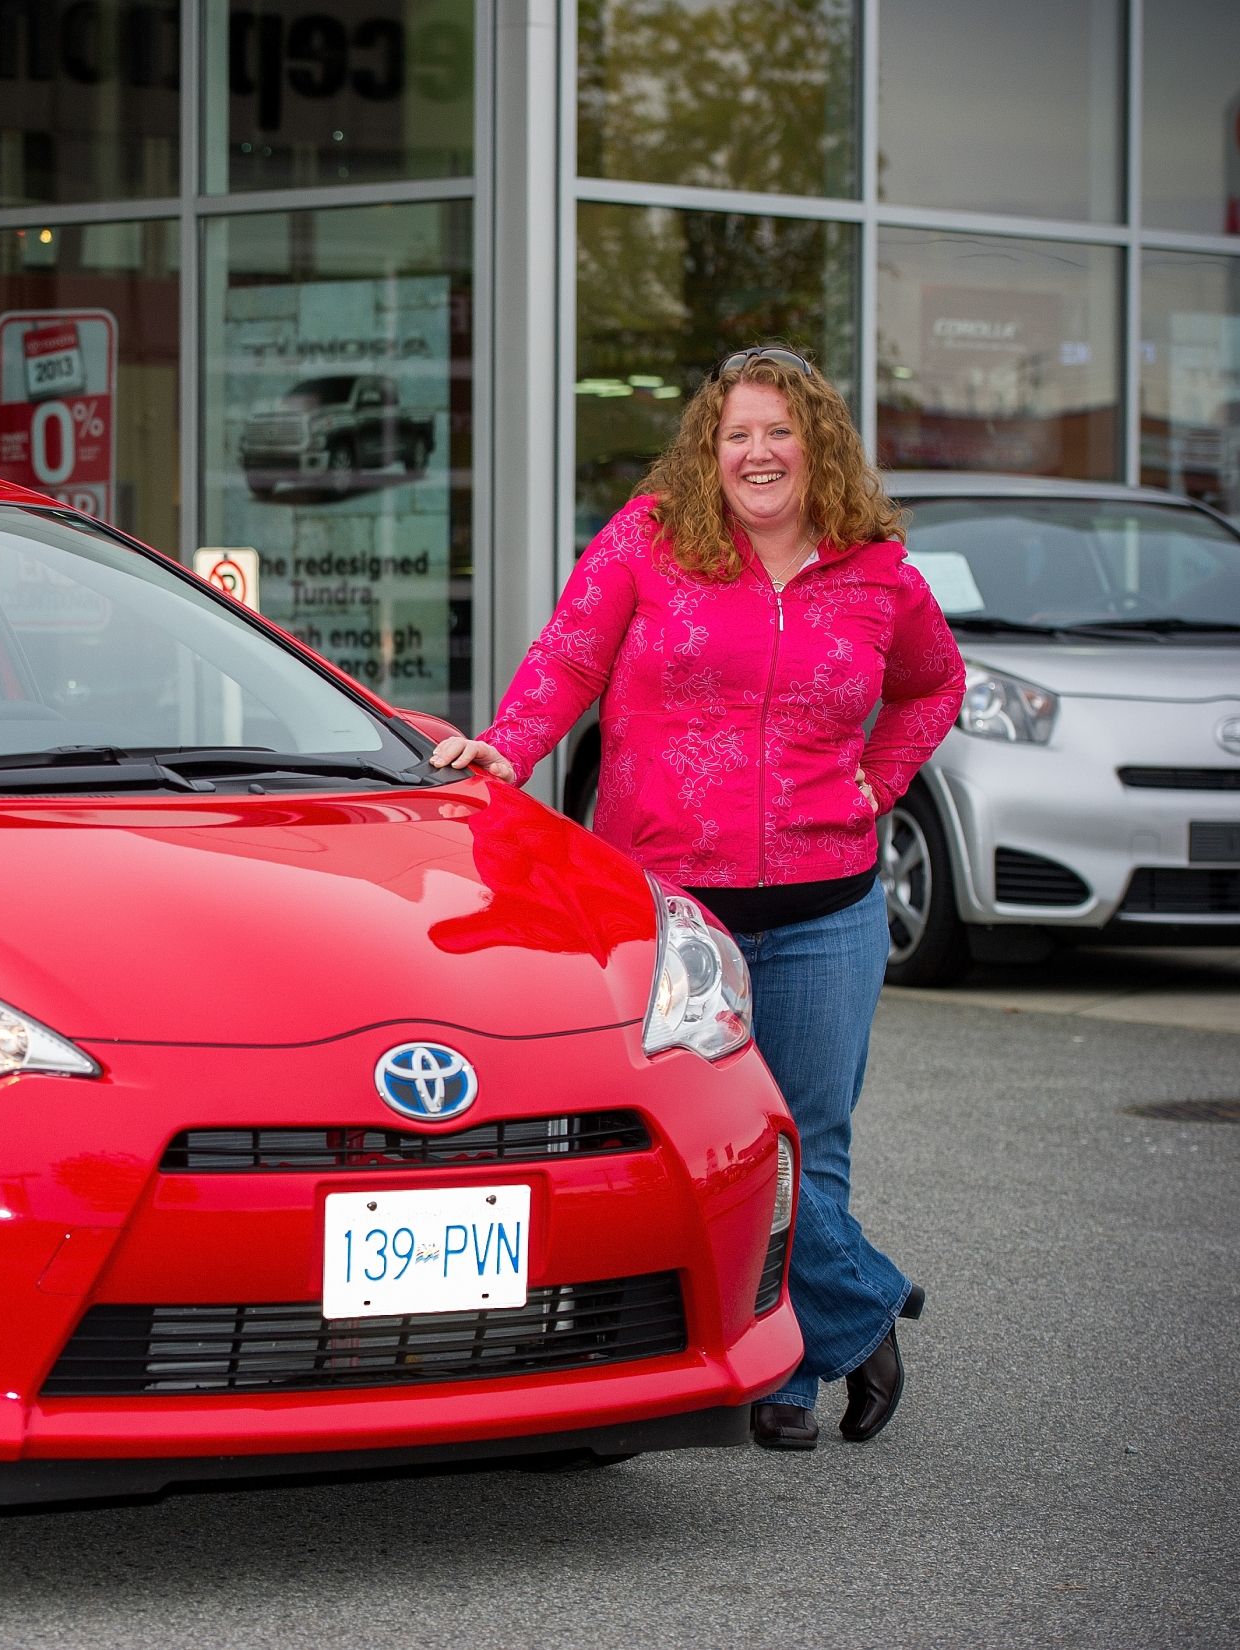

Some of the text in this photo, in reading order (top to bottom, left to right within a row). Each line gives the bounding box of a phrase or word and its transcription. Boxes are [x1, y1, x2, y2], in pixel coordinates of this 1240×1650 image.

[34, 355, 75, 384] 2013
[260, 550, 429, 582] he redesigned
[345, 1221, 521, 1283] 139 PVN
